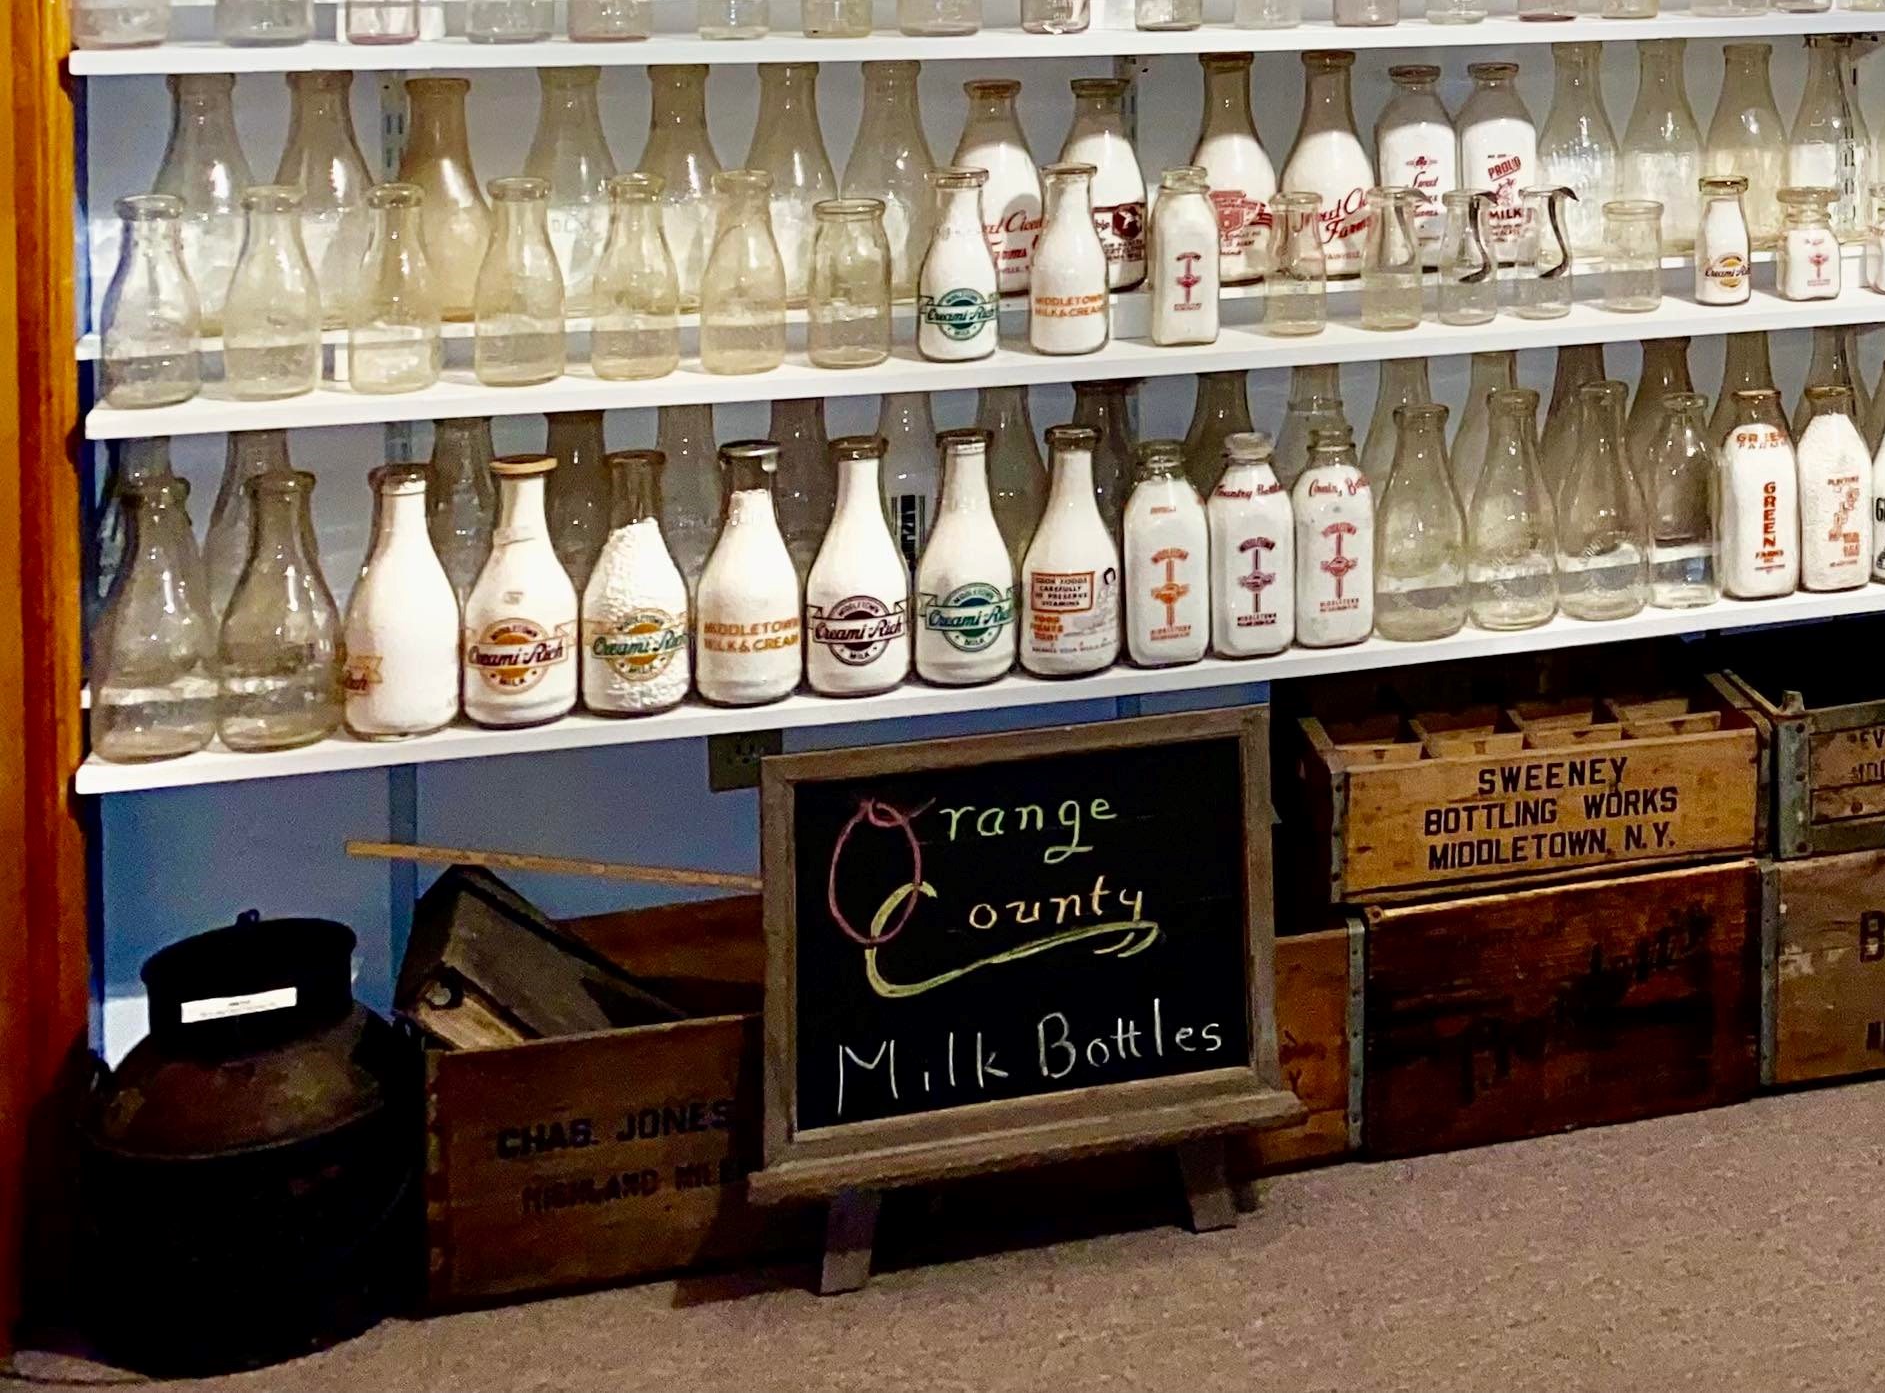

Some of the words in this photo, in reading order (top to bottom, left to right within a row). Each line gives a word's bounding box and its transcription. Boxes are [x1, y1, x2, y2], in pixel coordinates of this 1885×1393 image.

[1489, 208, 1523, 221] MILK
[849, 650, 872, 661] MILK
[1477, 756, 1629, 796] SWEENEY
[1423, 797, 1558, 837] BOTTLING
[1583, 785, 1680, 821] WORKS
[1624, 820, 1676, 851] N.Y.
[828, 796, 1118, 947] Orange
[865, 875, 1160, 998] County
[837, 1031, 1010, 1117] Milk
[1037, 997, 1223, 1079] Bottles
